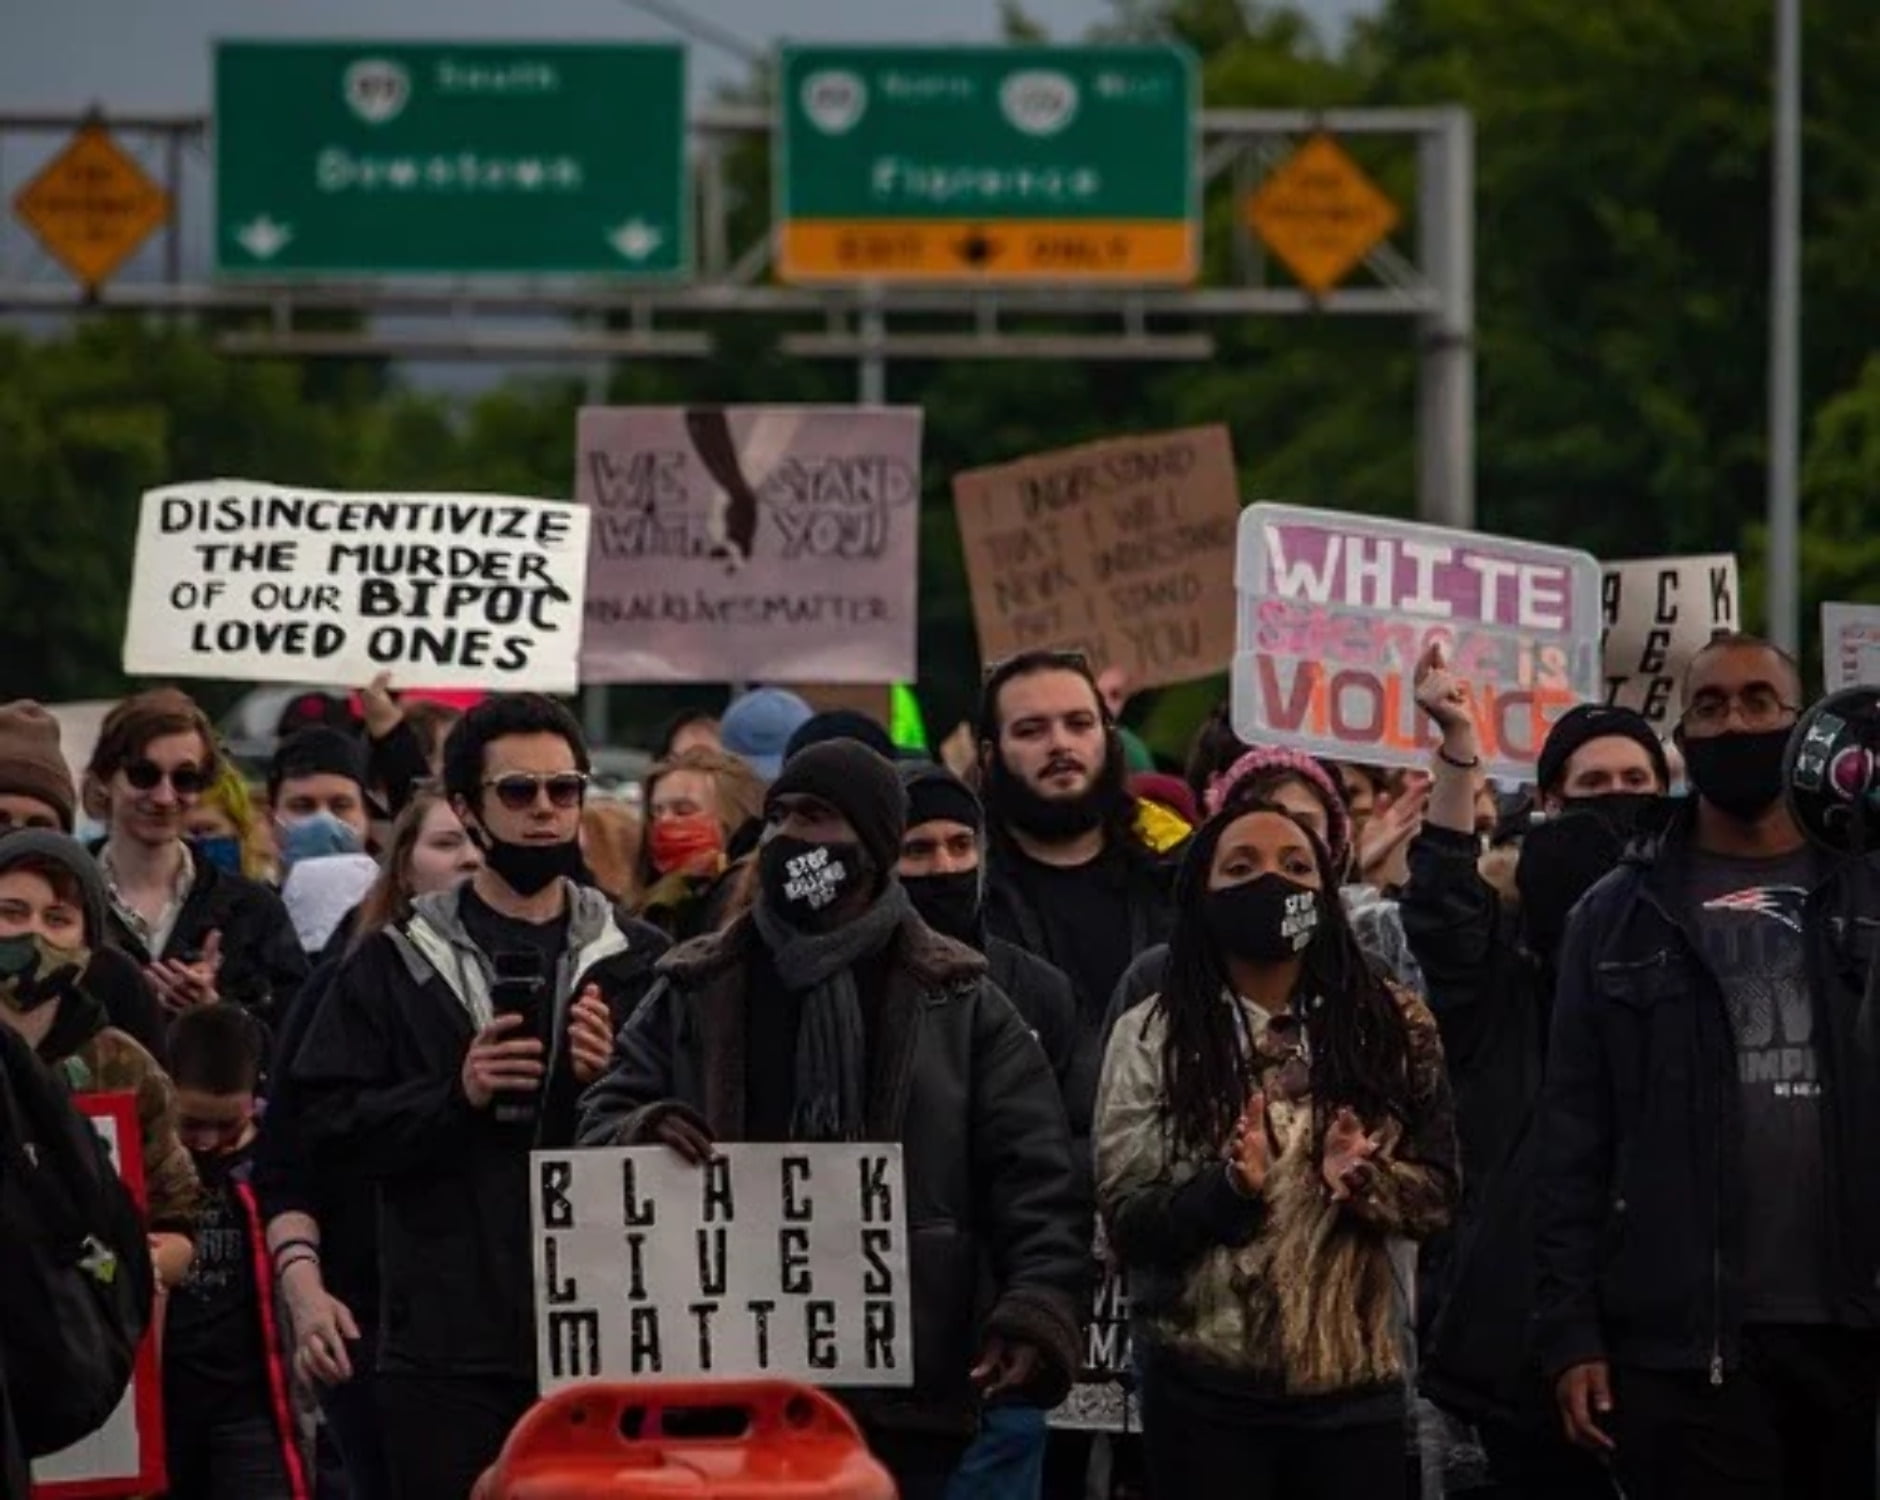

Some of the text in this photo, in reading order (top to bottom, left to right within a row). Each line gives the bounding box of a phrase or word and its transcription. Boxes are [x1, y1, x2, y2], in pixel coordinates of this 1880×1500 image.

[316, 145, 583, 191] Downtown
[160, 497, 571, 546] DISINCENTIVIZE
[194, 541, 571, 602] THE MURDER
[1264, 524, 1565, 630] WHITE
[171, 579, 559, 631] OF OUR BIPOC
[192, 620, 534, 671] LOVED ONES
[541, 1154, 892, 1229] BLACK
[544, 1228, 893, 1304] LIVES
[548, 1300, 896, 1377] MATTER
